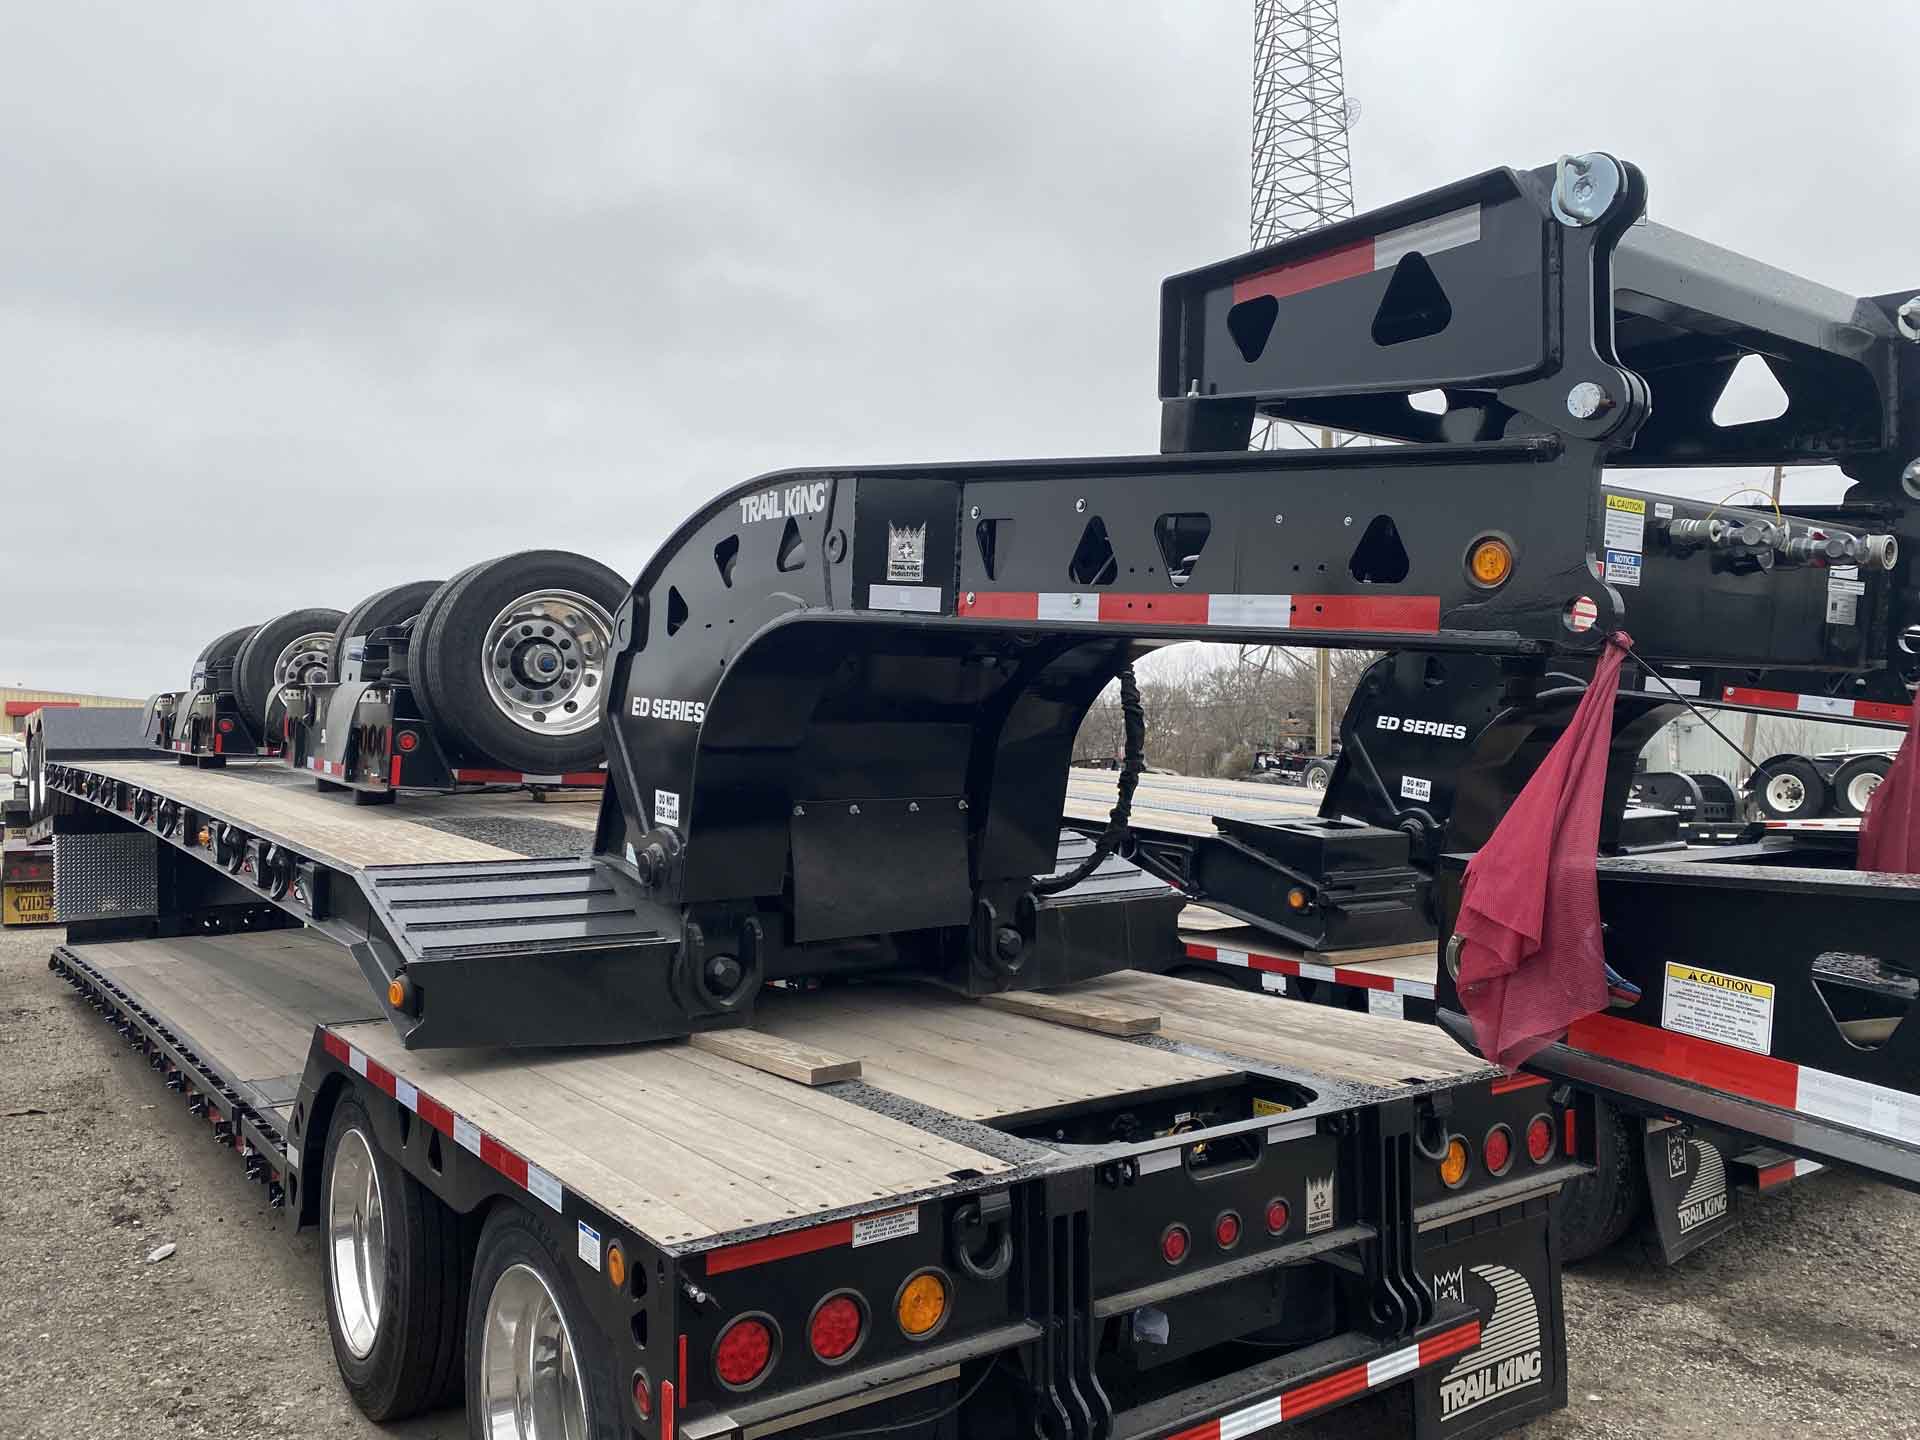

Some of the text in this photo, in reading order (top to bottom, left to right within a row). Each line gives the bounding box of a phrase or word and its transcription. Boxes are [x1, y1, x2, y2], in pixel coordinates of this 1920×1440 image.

[1616, 499, 1643, 512] CAUTION
[631, 696, 705, 723] ED SERIES
[1376, 715, 1467, 740] ED SERIES
[1403, 786, 1429, 798] SIDE LOAD
[1416, 781, 1426, 789] NOT
[19, 896, 51, 911] WIDE
[19, 912, 49, 922] TURNS
[1700, 973, 1753, 994] CAUTION
